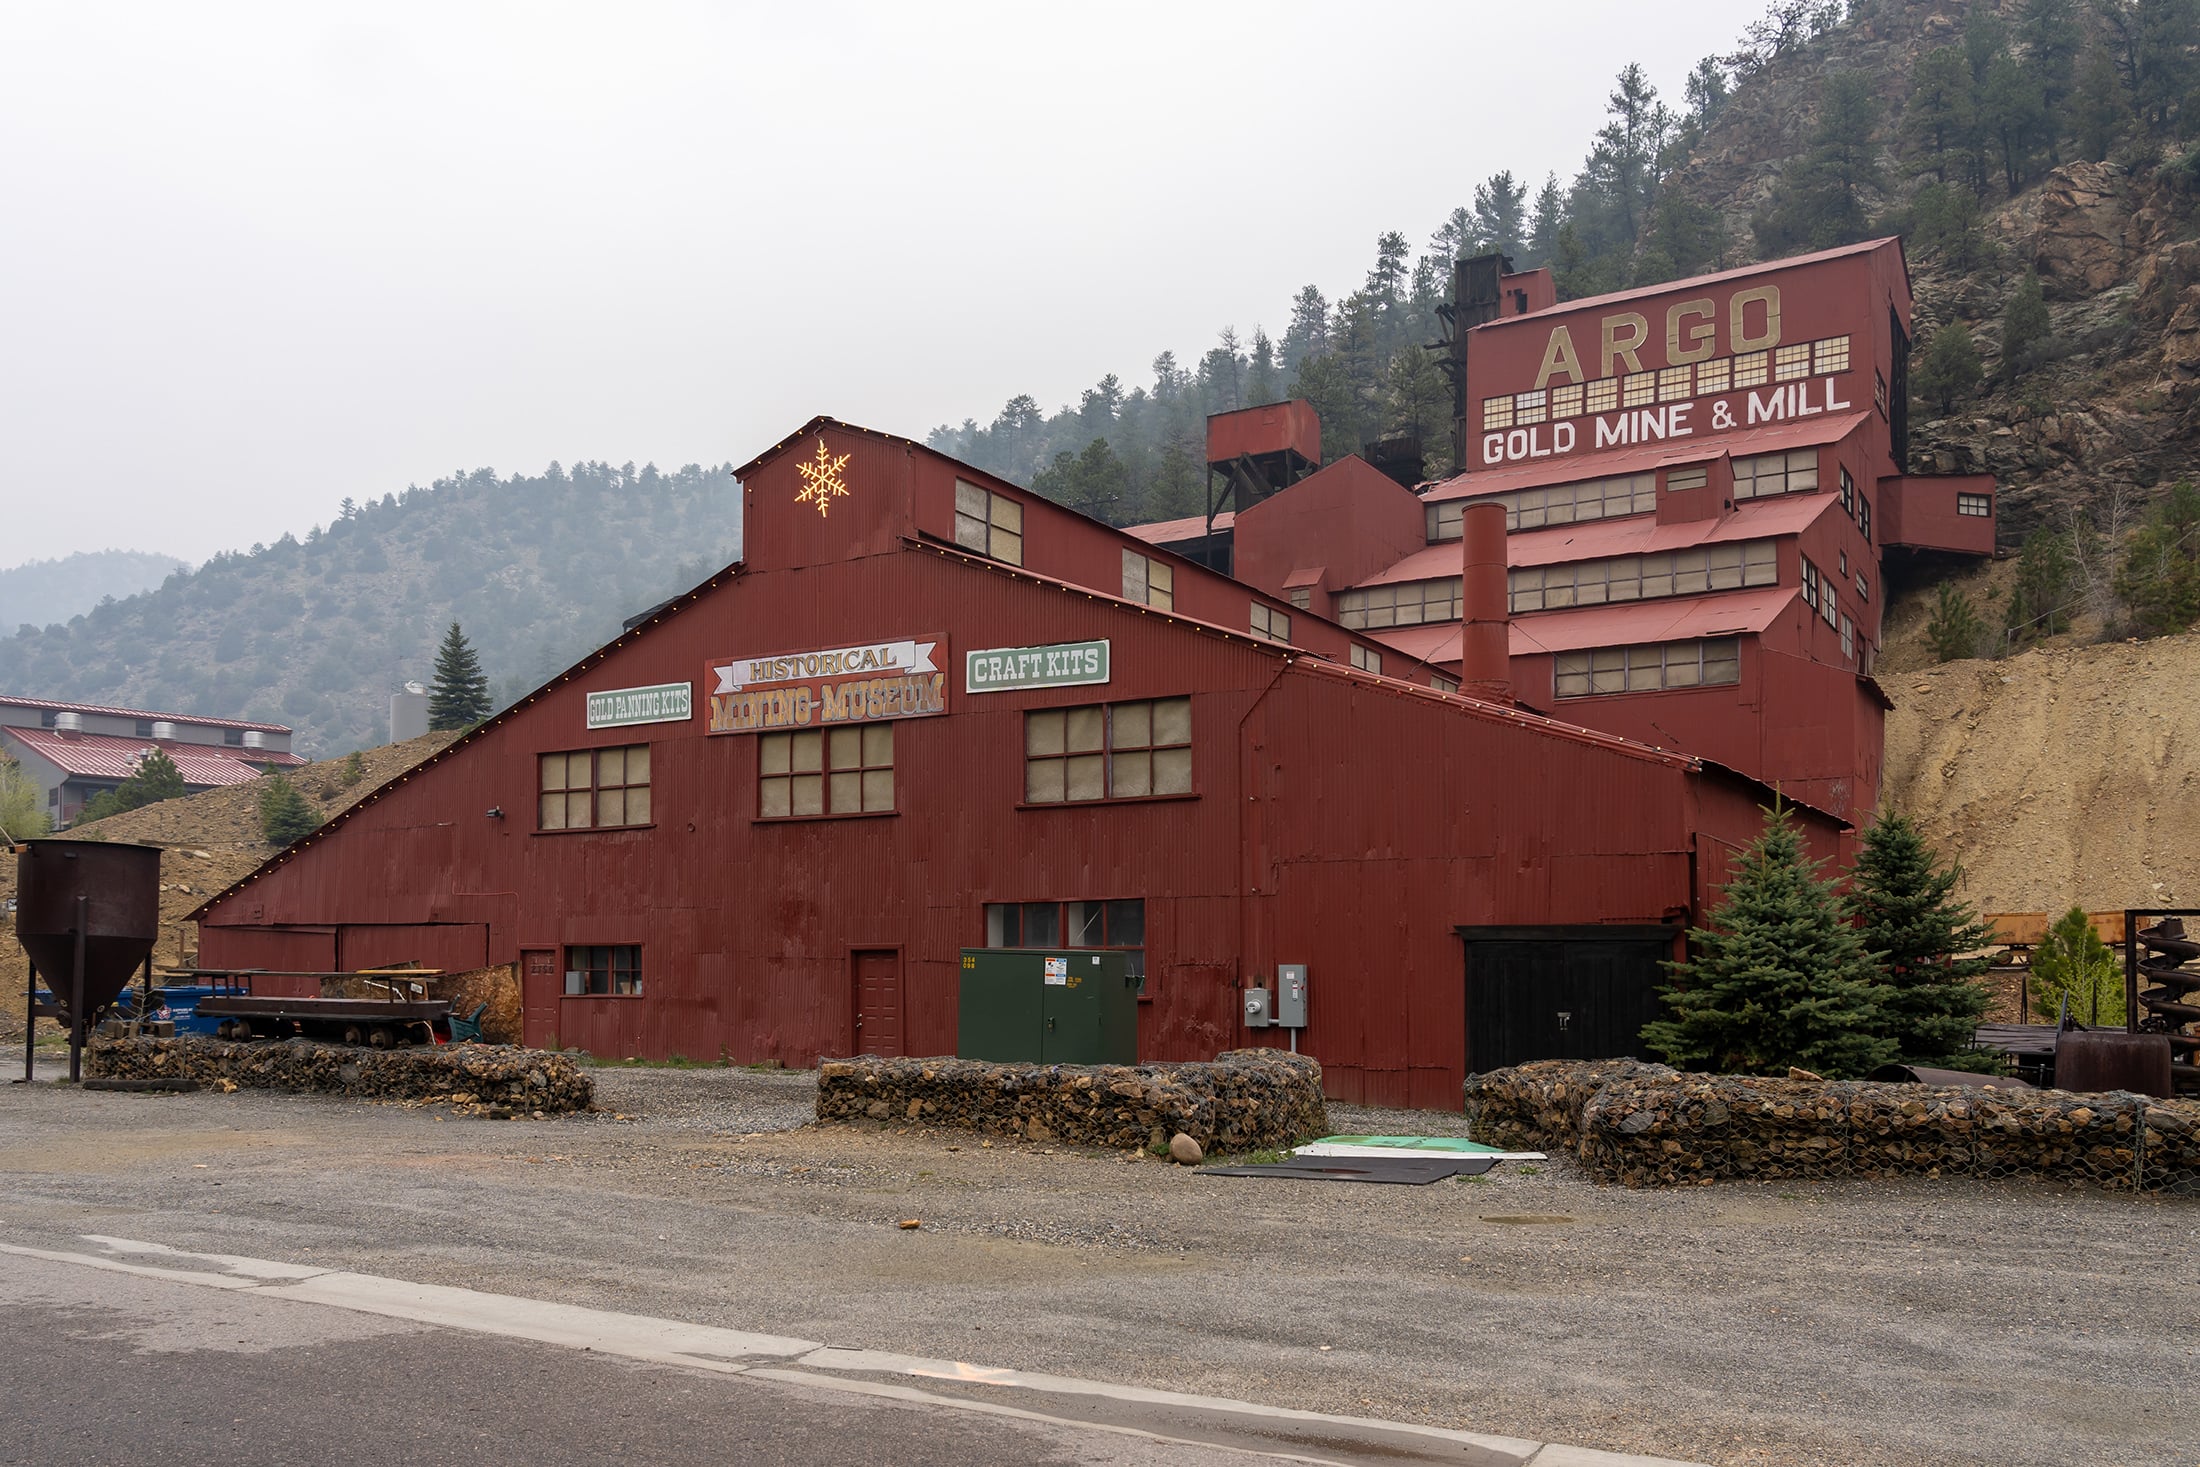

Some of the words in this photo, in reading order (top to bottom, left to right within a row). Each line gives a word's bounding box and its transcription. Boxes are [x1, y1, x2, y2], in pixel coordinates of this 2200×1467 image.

[1534, 284, 1782, 390] ARGO
[1483, 421, 1576, 464] GOLD
[1595, 402, 1694, 449] MINE
[1711, 399, 1738, 431] &
[1747, 376, 1851, 425] MILL
[749, 647, 897, 681] HISTORICAL
[974, 653, 1042, 683] CRAFT
[1046, 648, 1099, 677] KITS
[589, 697, 614, 722] GOLD
[615, 692, 660, 719] PANNING
[661, 688, 688, 714] KITS
